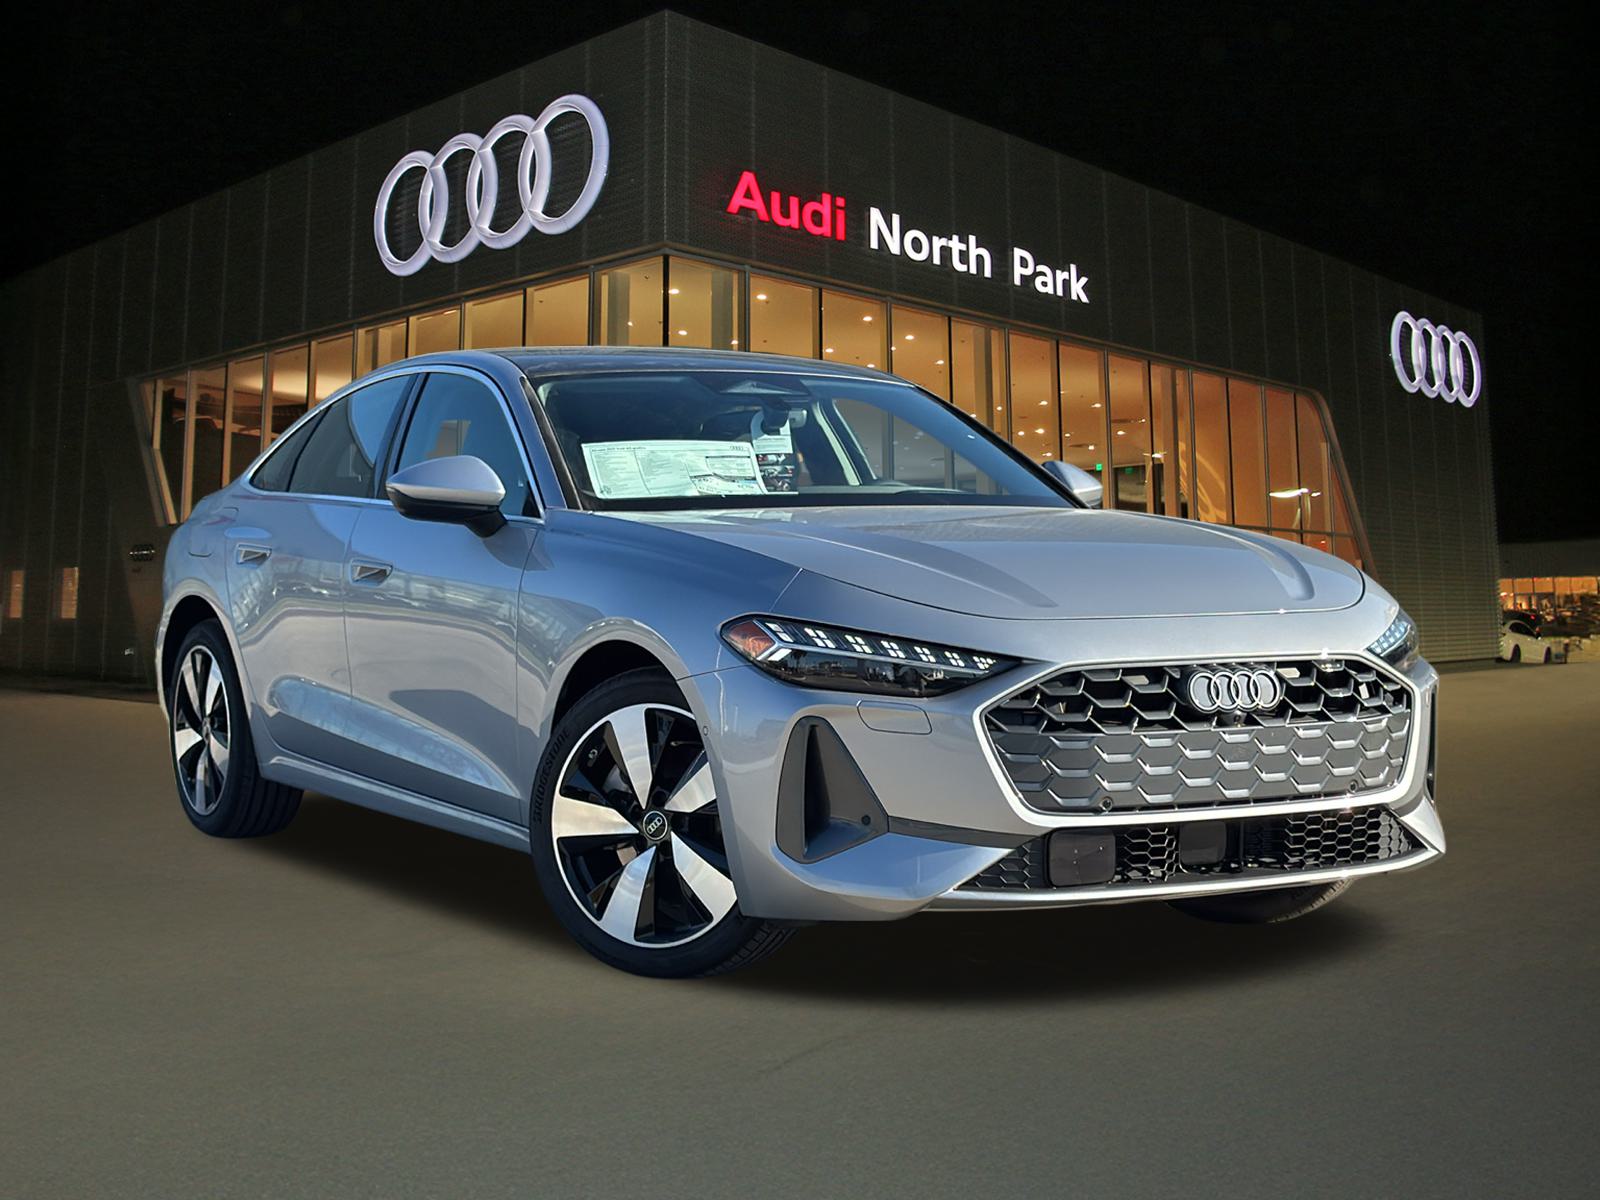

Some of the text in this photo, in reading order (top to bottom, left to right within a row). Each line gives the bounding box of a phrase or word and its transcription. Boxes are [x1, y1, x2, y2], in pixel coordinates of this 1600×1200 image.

[726, 170, 1090, 303] Audi North Park
